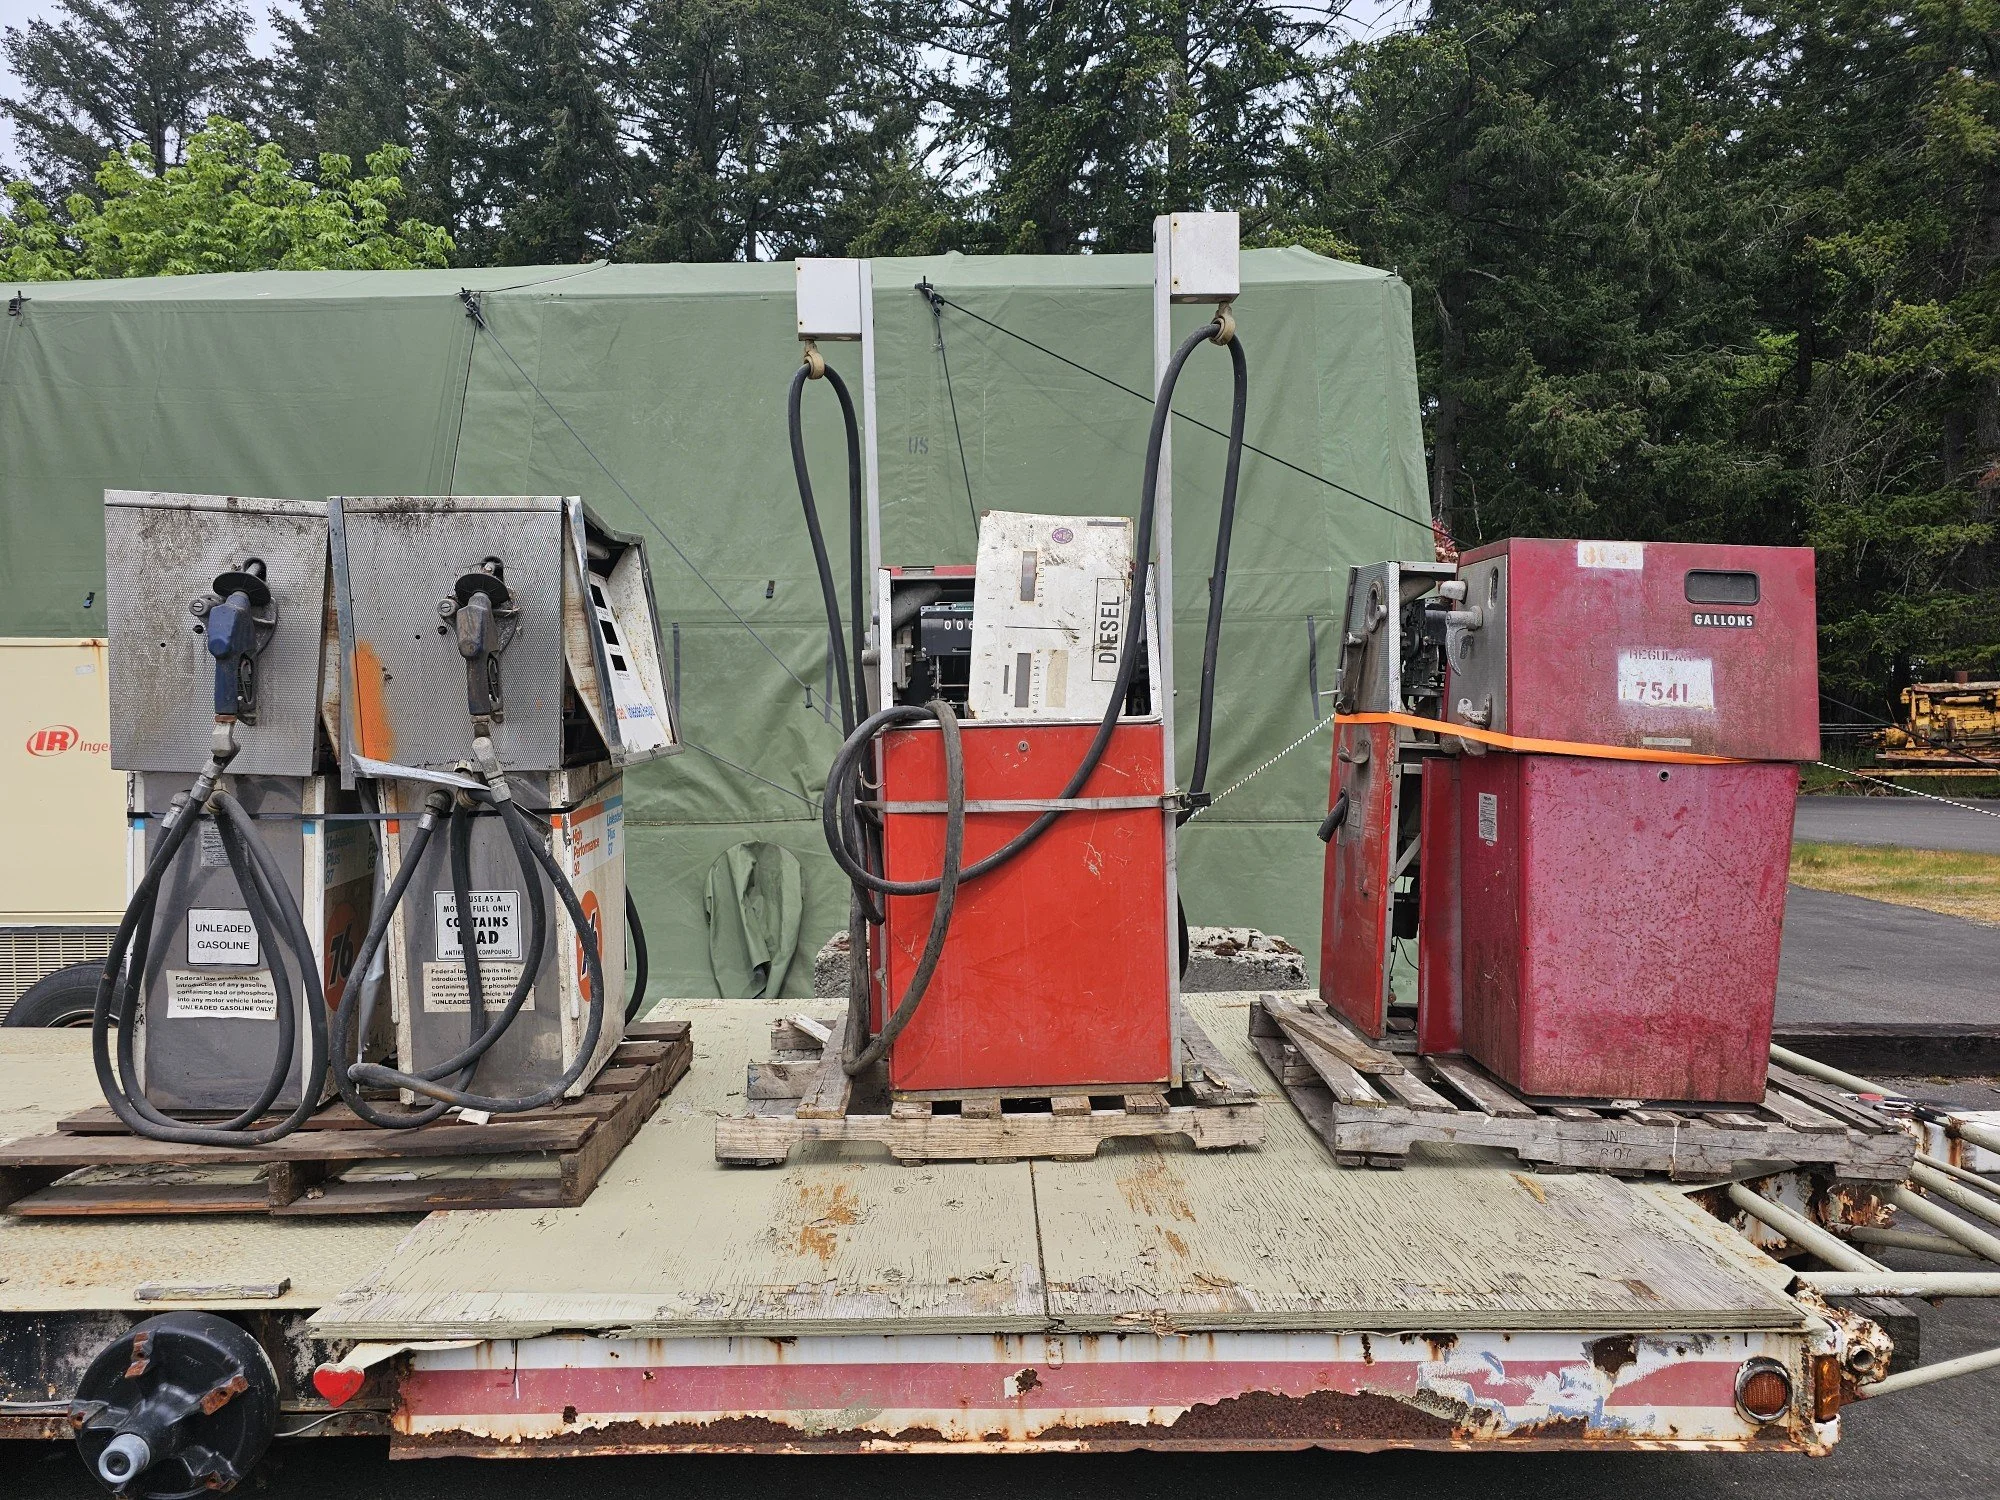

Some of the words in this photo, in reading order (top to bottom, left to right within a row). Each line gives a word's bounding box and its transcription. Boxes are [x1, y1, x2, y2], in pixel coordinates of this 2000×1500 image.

[908, 436, 928, 454] US
[1694, 614, 1753, 626] GALLONS
[1098, 596, 1120, 664] DIESEL
[1032, 659, 1041, 705] GALLONS
[1636, 681, 1688, 702] 7541
[35, 731, 70, 750] IR
[326, 851, 340, 868] Plus
[443, 905, 458, 913] MOT
[472, 905, 490, 913] FUEL
[492, 904, 511, 912] ONLY
[195, 924, 251, 933] UNLEADED
[446, 917, 509, 928] COTAINS
[197, 941, 250, 950] GASOLINE
[457, 931, 499, 945] LAD
[328, 922, 354, 989] 76
